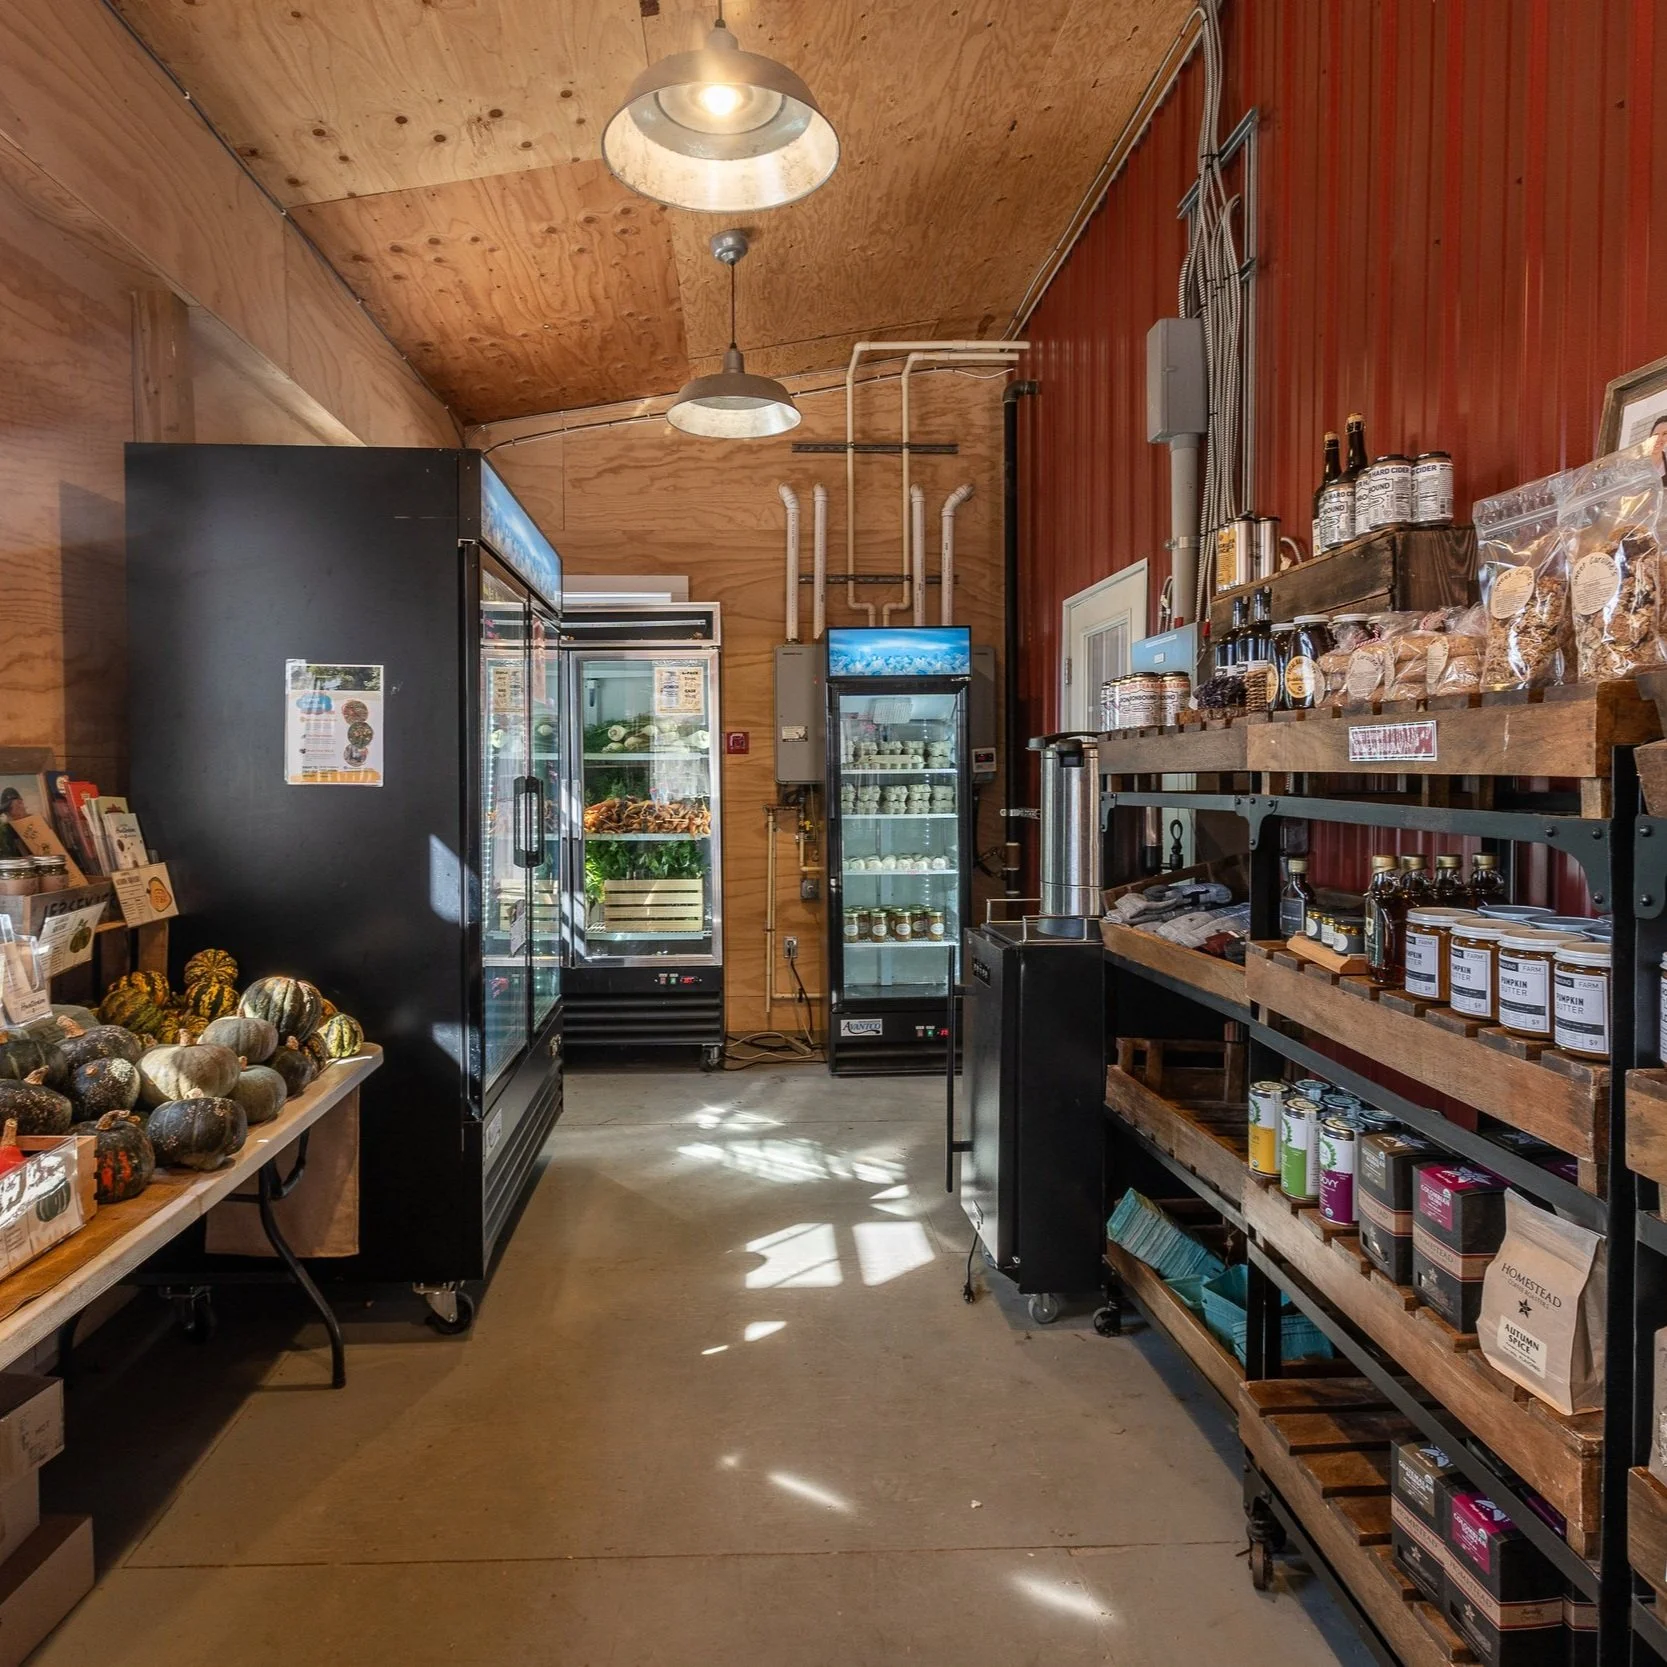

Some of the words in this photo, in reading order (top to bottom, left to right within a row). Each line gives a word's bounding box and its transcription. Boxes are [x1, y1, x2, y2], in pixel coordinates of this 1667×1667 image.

[1372, 468, 1390, 478] HARD
[1415, 465, 1437, 475] CIDER
[1368, 481, 1391, 494] BOUND
[1522, 965, 1542, 973] FARM
[1578, 981, 1599, 989] FARM
[1556, 992, 1584, 1006] PUMPKIN
[843, 1021, 881, 1034] AVANTCO
[1501, 1263, 1562, 1308] HOMESTEAD
[1504, 1323, 1540, 1351] AUTUMN
[1508, 1334, 1531, 1354] SPICE
